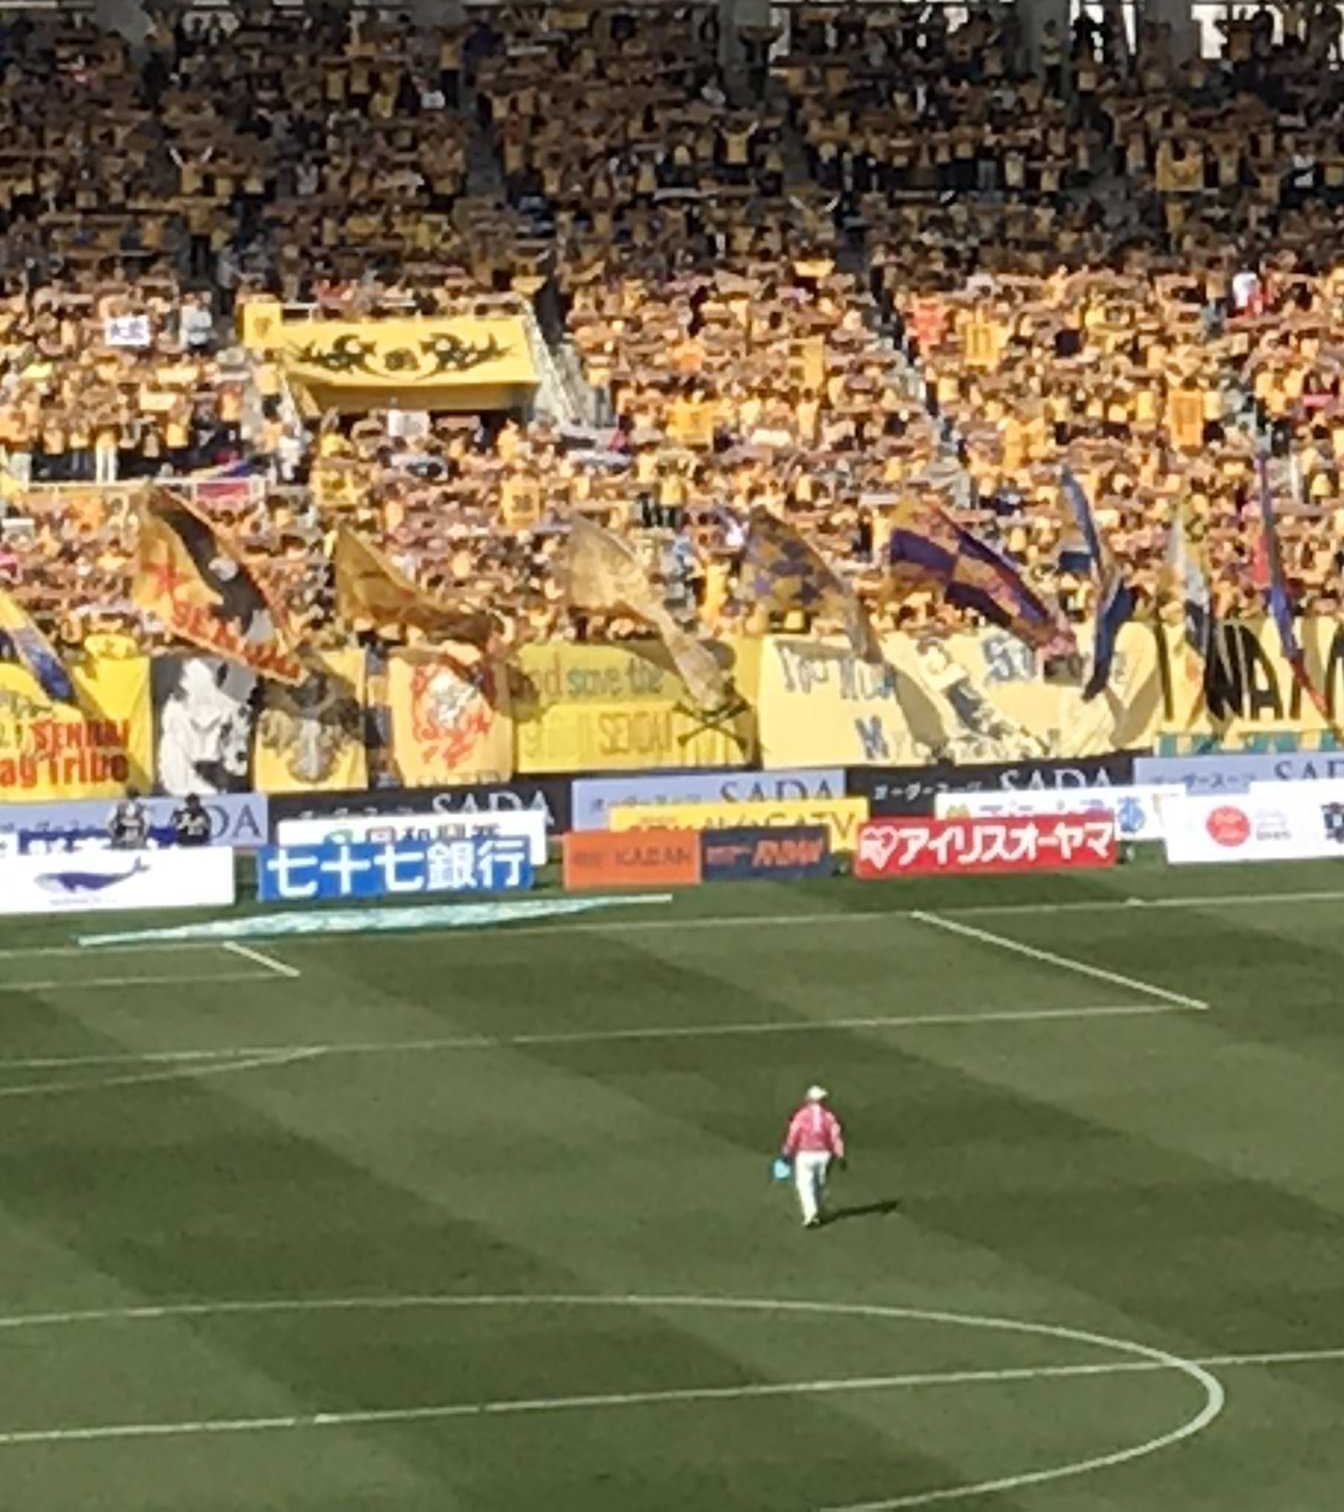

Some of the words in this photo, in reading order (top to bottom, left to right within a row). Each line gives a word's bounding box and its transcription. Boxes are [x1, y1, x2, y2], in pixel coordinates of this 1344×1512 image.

[267, 839, 527, 897] 七十七銀行
[896, 820, 1116, 866] アイリスオーヤマ
